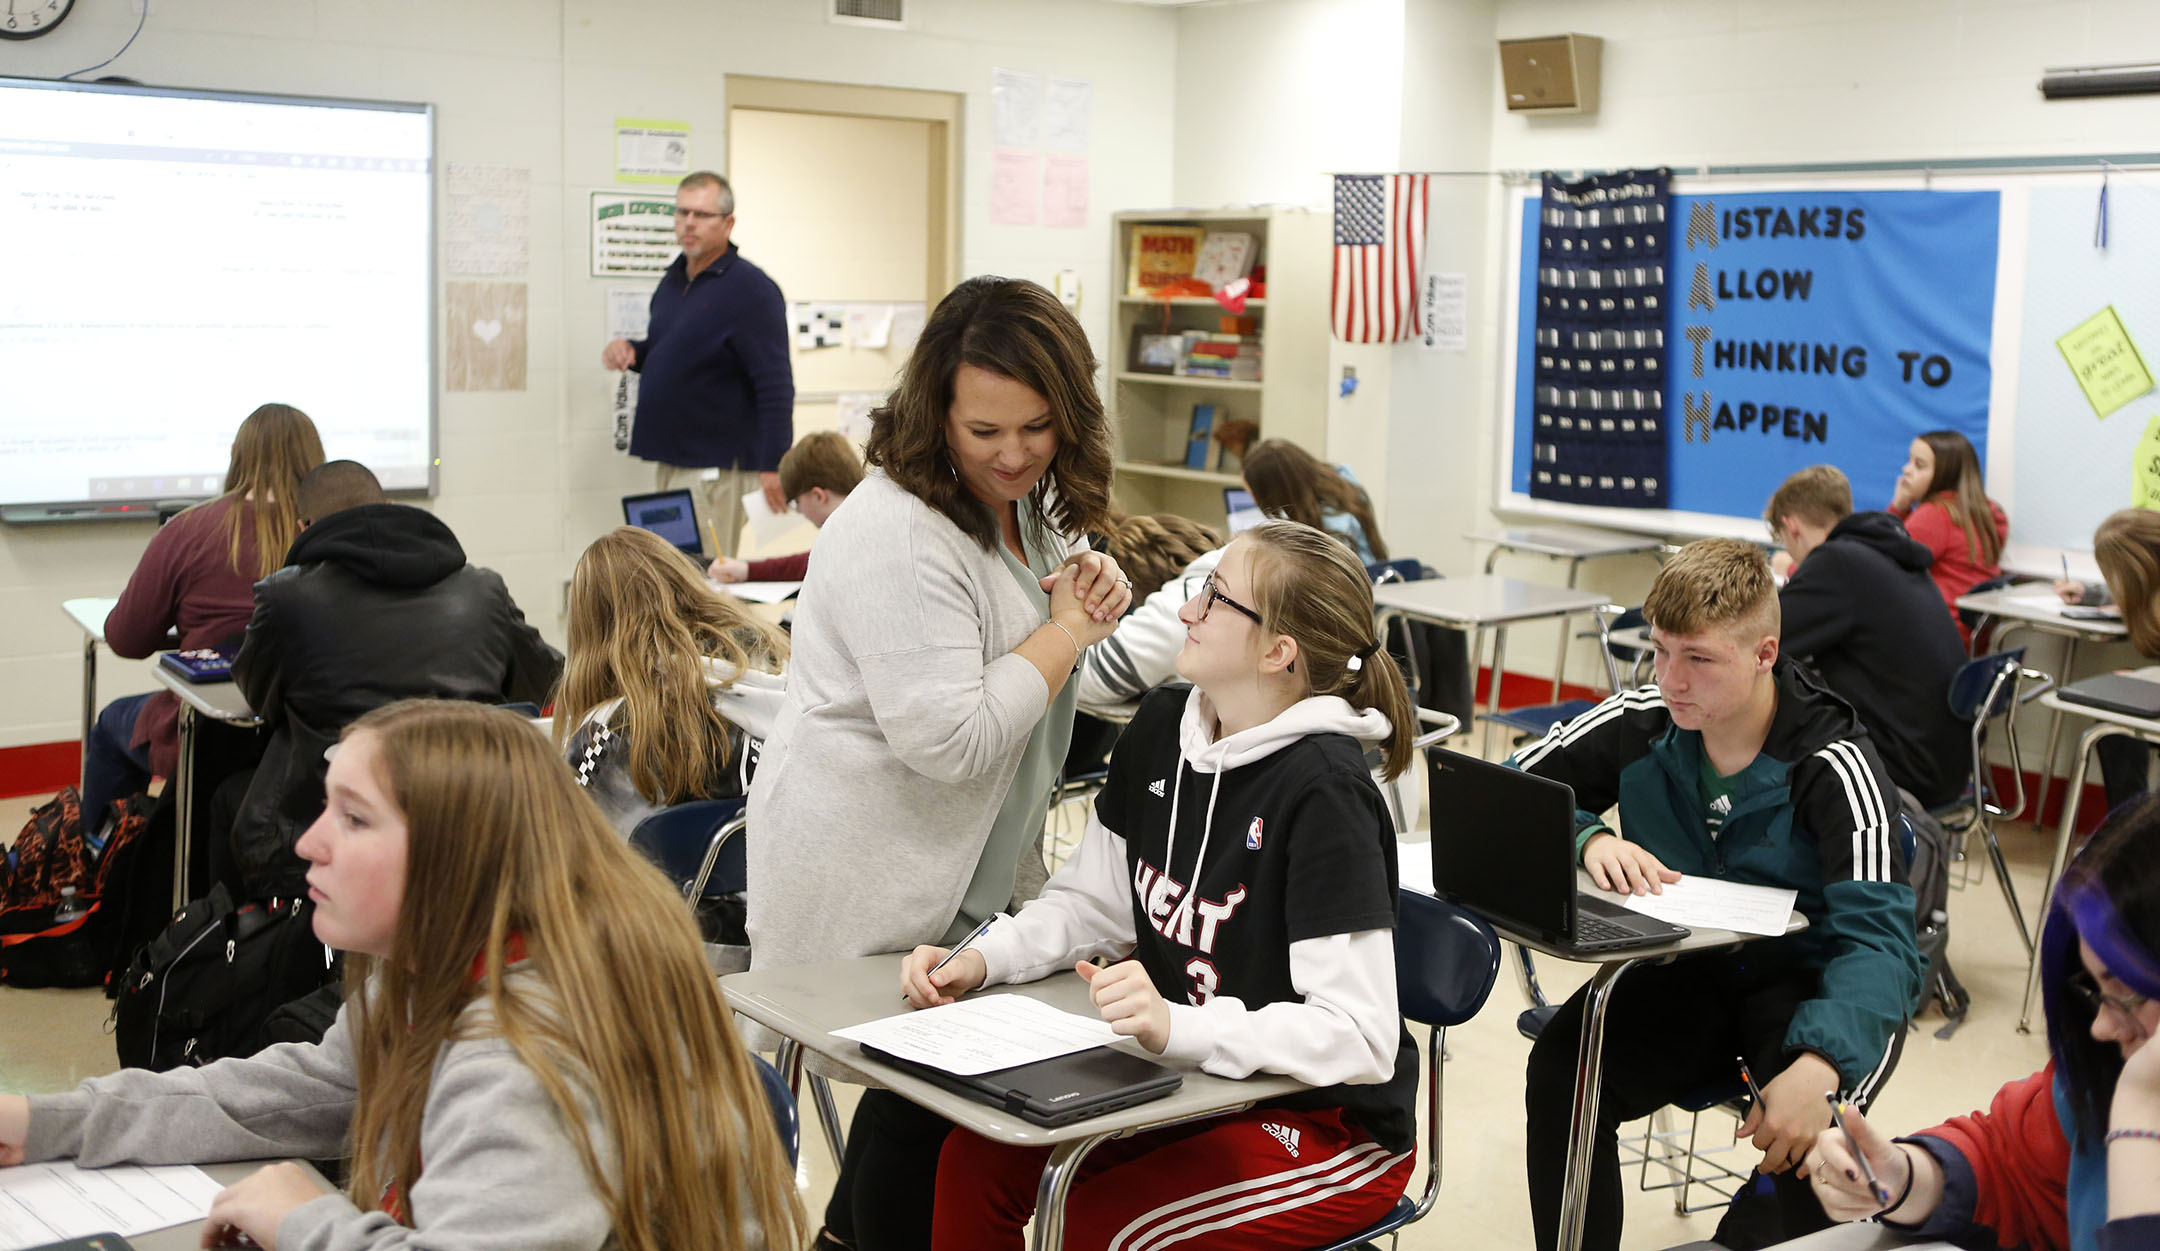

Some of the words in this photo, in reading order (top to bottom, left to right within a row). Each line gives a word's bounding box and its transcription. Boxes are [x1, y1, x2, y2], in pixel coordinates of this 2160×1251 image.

[7, 16, 17, 29] 6
[1688, 260, 1813, 312] ALLOW
[1685, 325, 1868, 378] THINKING
[1897, 351, 1952, 387] TO
[1684, 391, 1828, 444] HAPPEN
[1134, 857, 1248, 957] HEAT
[1185, 956, 1221, 1007] 3
[1261, 1122, 1300, 1158] adidas
